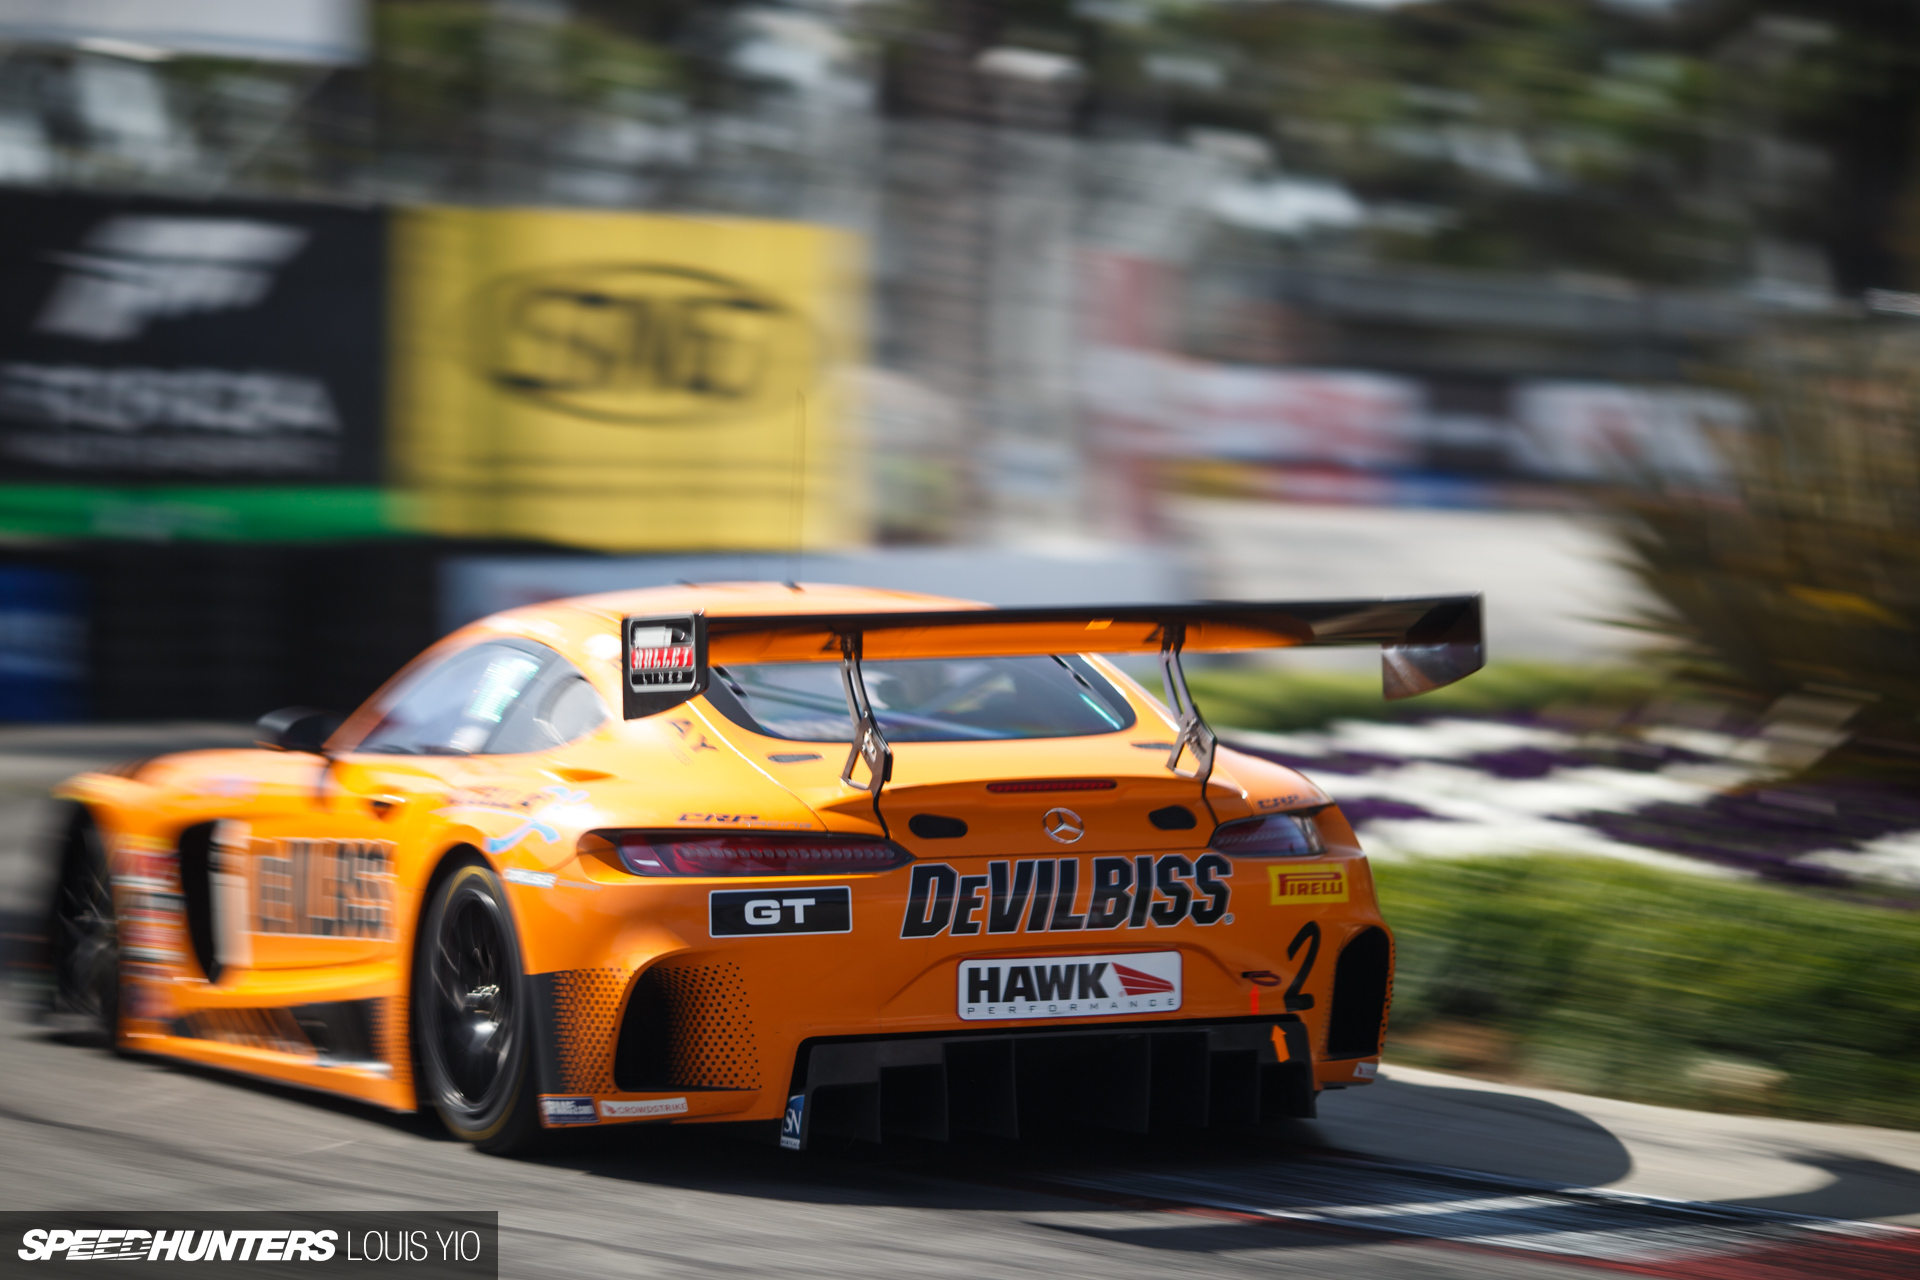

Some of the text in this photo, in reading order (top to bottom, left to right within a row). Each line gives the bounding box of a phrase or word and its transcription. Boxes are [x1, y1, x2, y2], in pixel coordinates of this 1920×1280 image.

[1278, 872, 1342, 896] PIRELLI
[744, 898, 815, 926] GT
[1283, 920, 1321, 1013] 2
[967, 962, 1110, 1004] HAWK
[967, 998, 1175, 1015] PERFORMANCE
